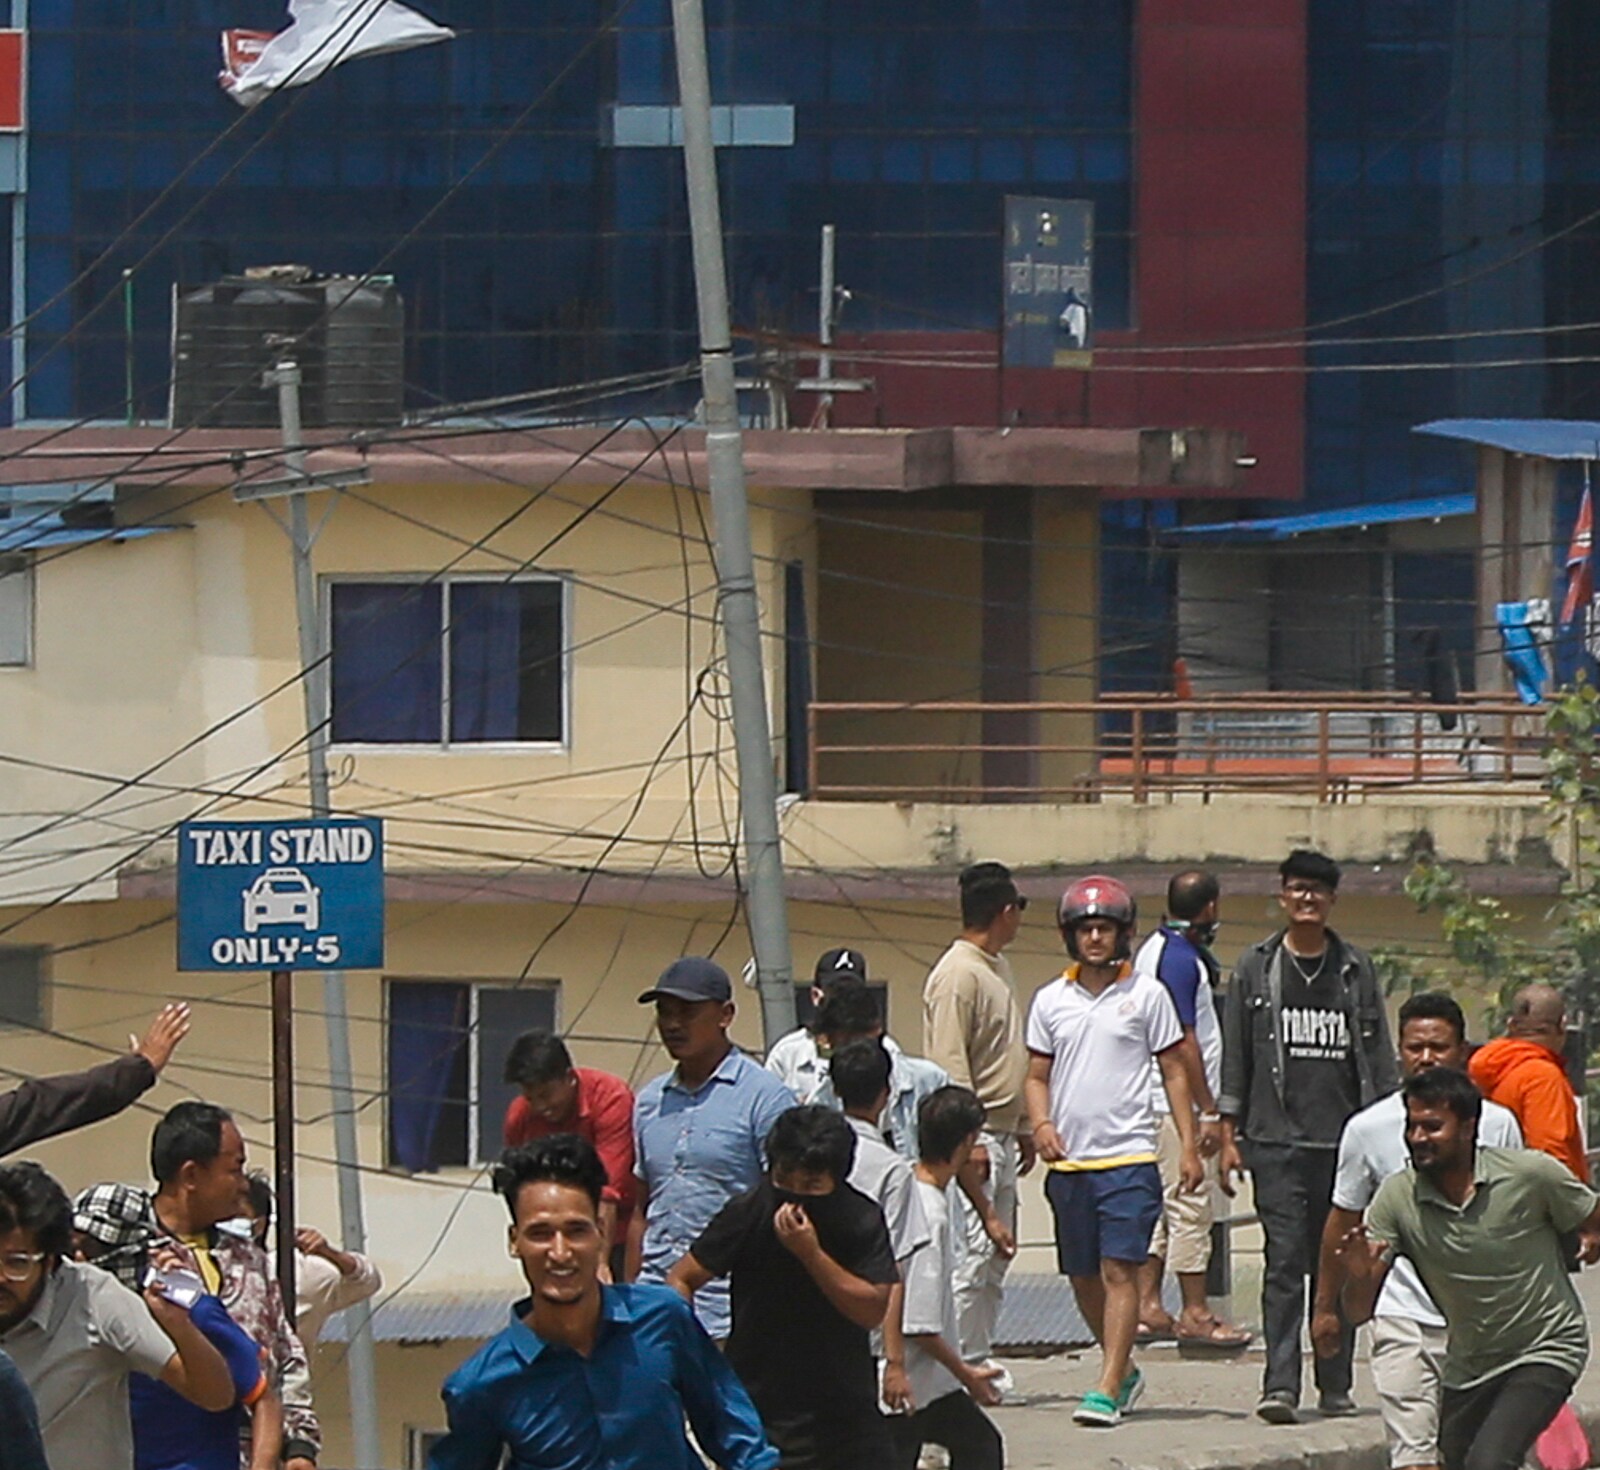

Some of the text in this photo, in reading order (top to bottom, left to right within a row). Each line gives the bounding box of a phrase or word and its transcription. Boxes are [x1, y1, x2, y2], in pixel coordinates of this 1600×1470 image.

[189, 827, 374, 864] TAXI STAND
[211, 935, 340, 964] ONLY-5
